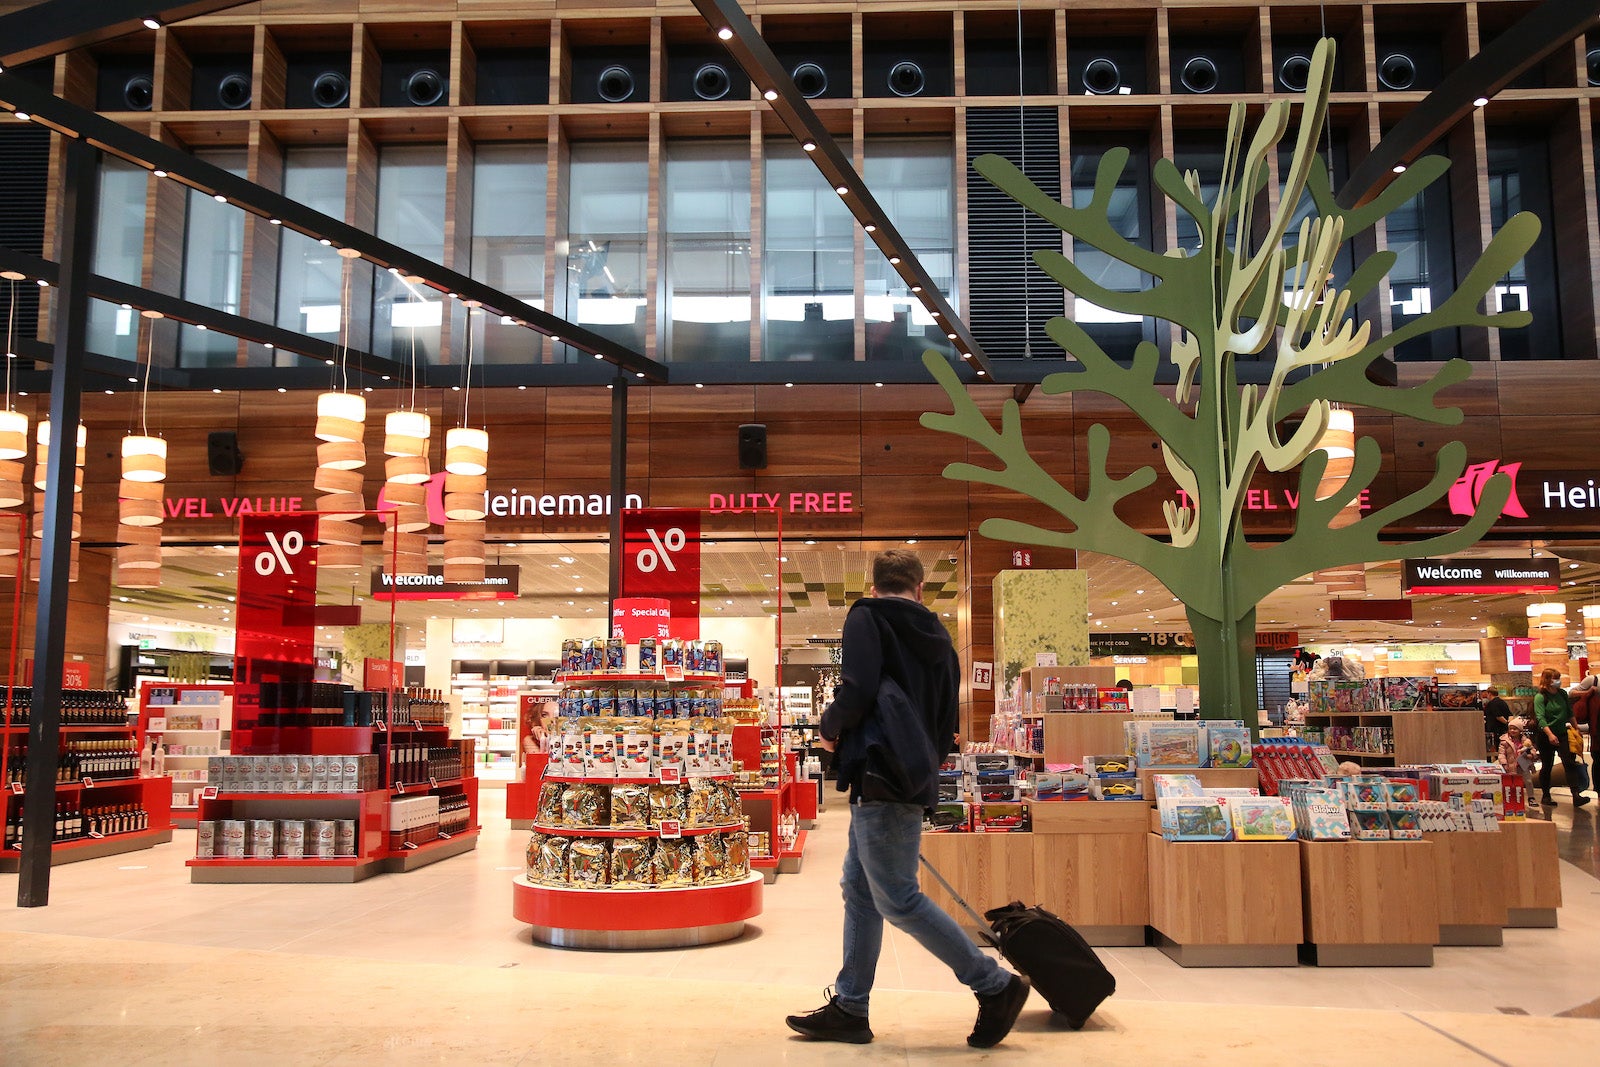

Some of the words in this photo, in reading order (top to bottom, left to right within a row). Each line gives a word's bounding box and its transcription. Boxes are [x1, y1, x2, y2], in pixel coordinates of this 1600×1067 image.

[709, 493, 780, 514] DUTY
[789, 492, 853, 513] FREE
[1417, 565, 1482, 580] Welcome
[1495, 569, 1550, 579] Willkommen
[631, 607, 658, 618] Special
